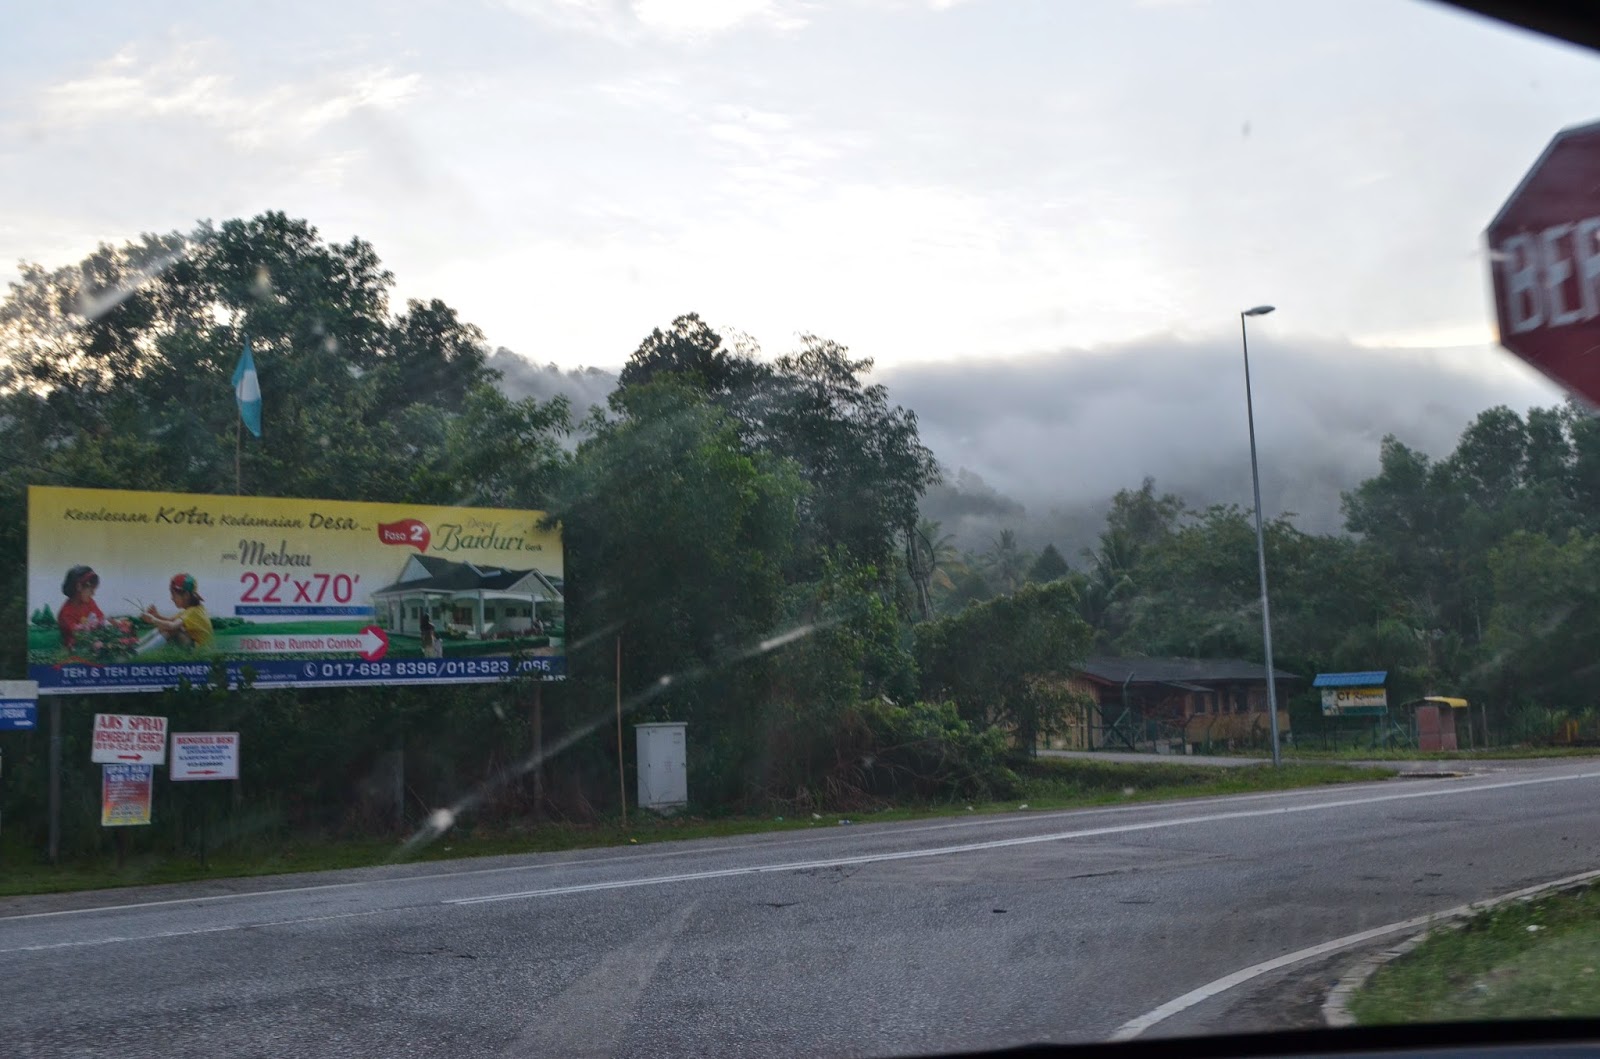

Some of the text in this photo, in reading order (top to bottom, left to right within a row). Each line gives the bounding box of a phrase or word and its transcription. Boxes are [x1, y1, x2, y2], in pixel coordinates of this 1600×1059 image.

[220, 512, 304, 528] Kedamaian
[410, 525, 423, 541] 2
[432, 522, 526, 551] Baiduri
[239, 539, 312, 567] Merbau
[274, 638, 286, 650] ke
[288, 637, 325, 650] Rumah
[328, 637, 362, 650] Contoh
[62, 667, 87, 678] TEH
[90, 667, 100, 678] &
[104, 666, 128, 677] TEH
[322, 663, 392, 677] 017-692
[128, 716, 164, 731] SPRAY
